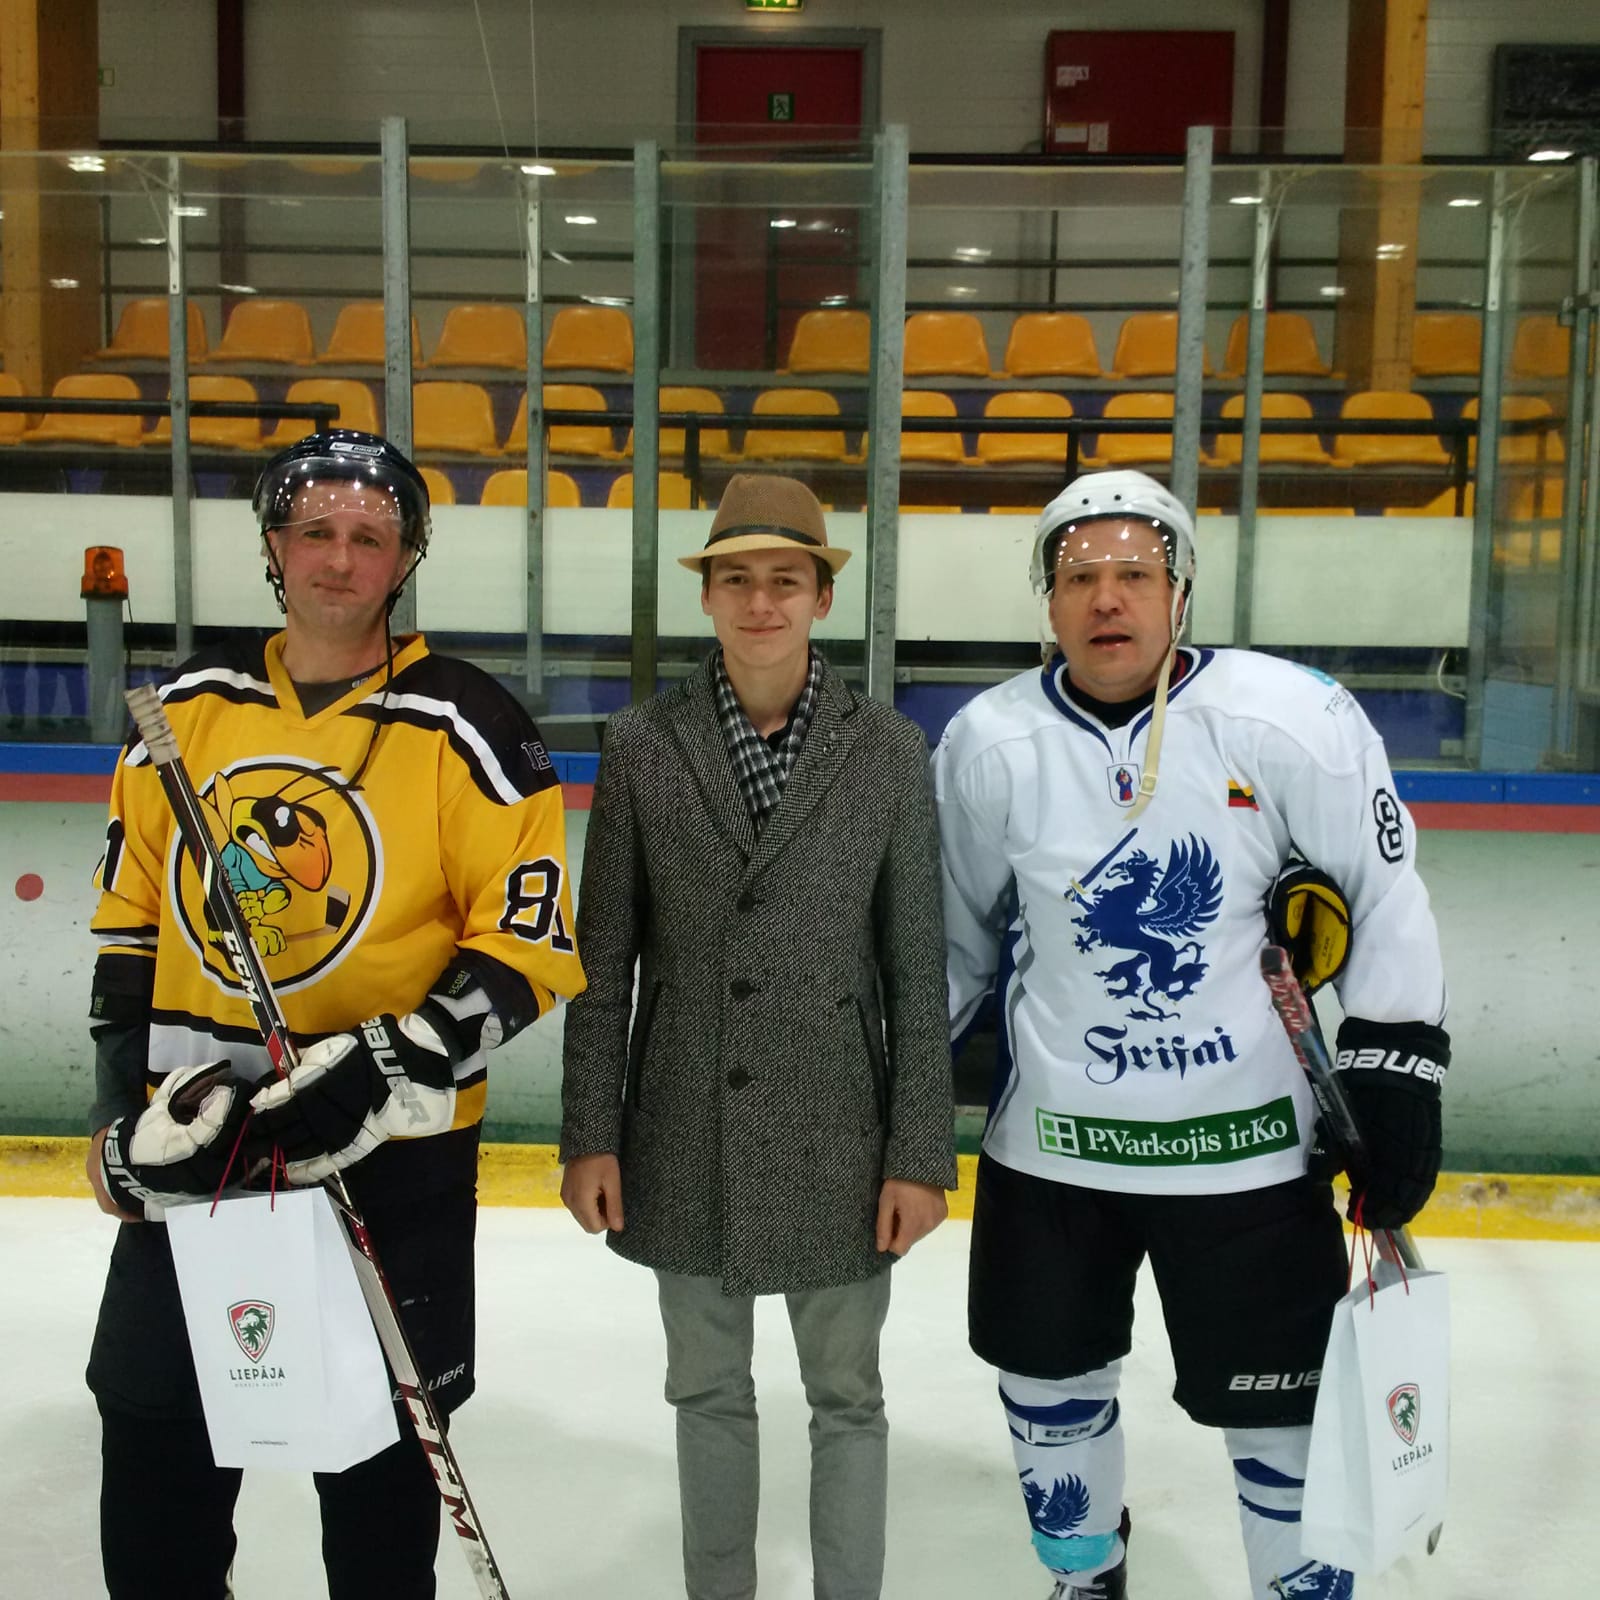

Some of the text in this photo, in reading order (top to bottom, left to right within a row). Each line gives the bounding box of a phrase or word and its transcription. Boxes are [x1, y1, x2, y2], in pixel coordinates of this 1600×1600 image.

[498, 856, 575, 955] 81
[223, 929, 262, 1004] CCM
[1084, 1024, 1239, 1085] Grifai
[1335, 1048, 1447, 1087] BAUER
[1085, 1126, 1222, 1161] P.Varkojis
[229, 1365, 286, 1380] LIEPĀJA
[1228, 1369, 1323, 1391] BAUE
[399, 1381, 480, 1542] CCM
[1392, 1443, 1433, 1471] LIEPĀJA
